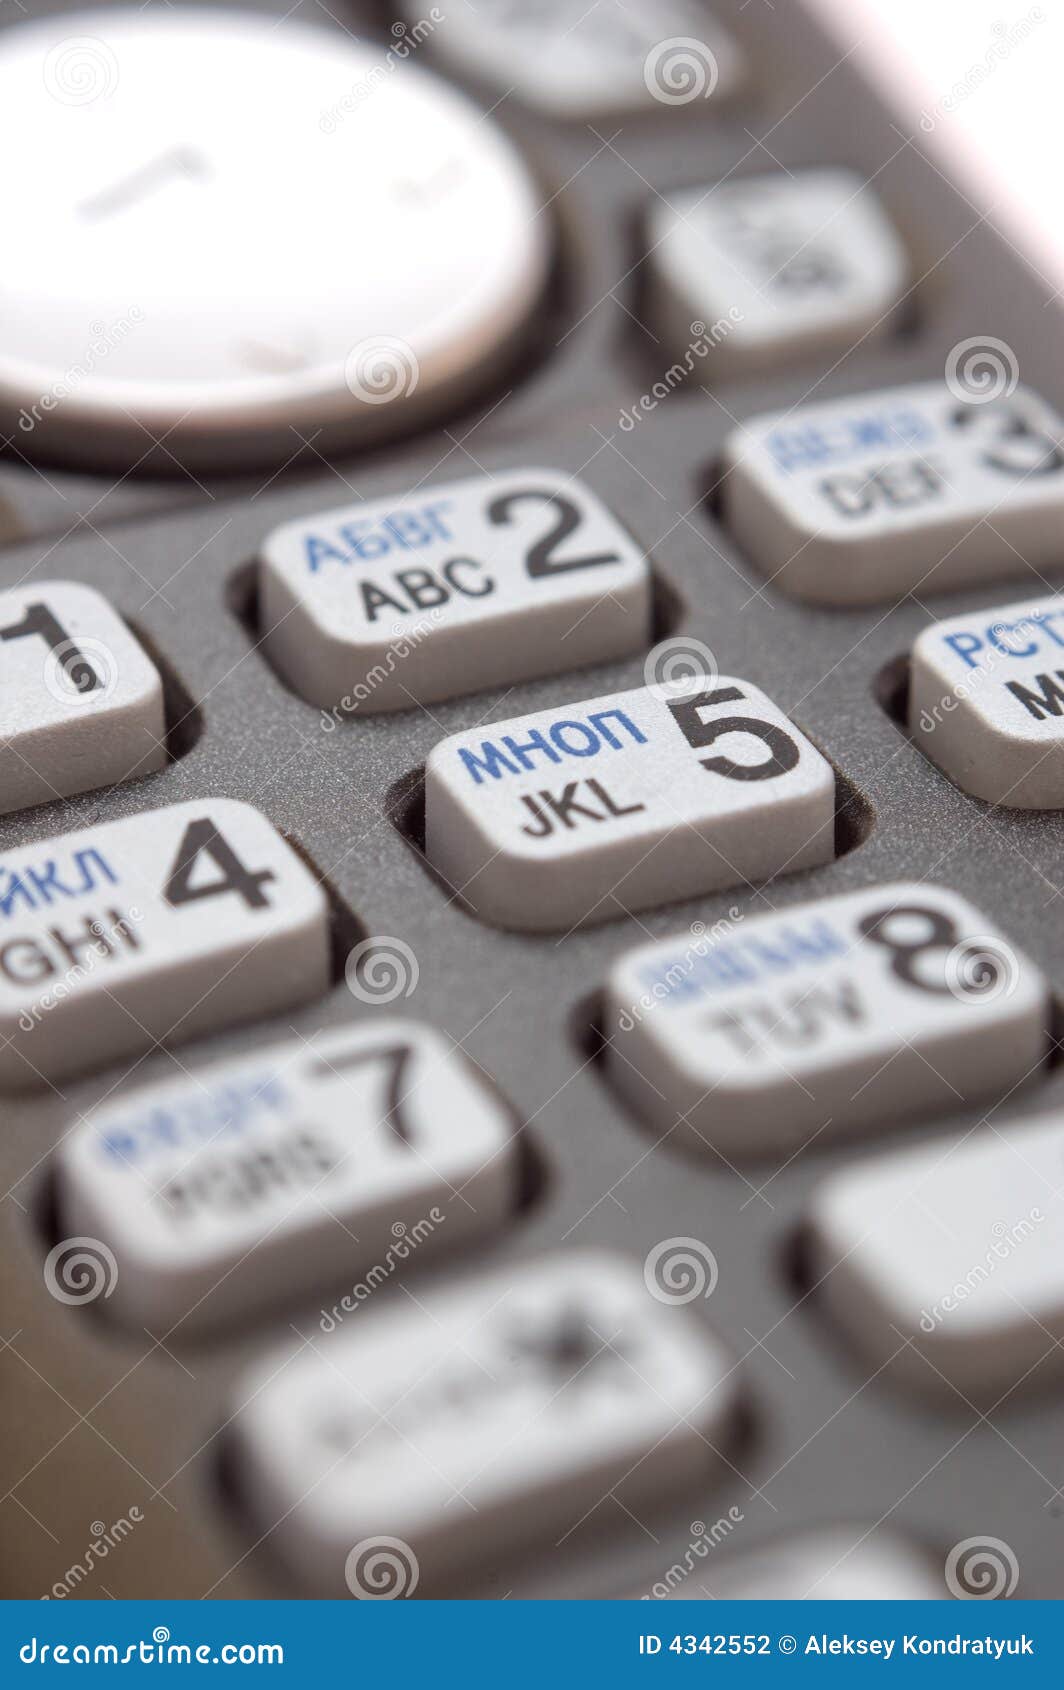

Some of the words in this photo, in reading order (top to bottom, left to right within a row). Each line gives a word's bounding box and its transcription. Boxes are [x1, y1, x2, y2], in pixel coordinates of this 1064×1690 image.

[946, 396, 1064, 482] 3
[303, 500, 458, 576] АБВГ
[485, 489, 621, 580] 2
[357, 556, 496, 623] ABC
[0, 602, 105, 694] 1
[457, 708, 649, 785] МНОП
[665, 686, 801, 782] 5
[517, 776, 646, 839] JKL
[162, 817, 279, 912] 4
[857, 902, 1002, 998] 8
[303, 1042, 415, 1145] 7
